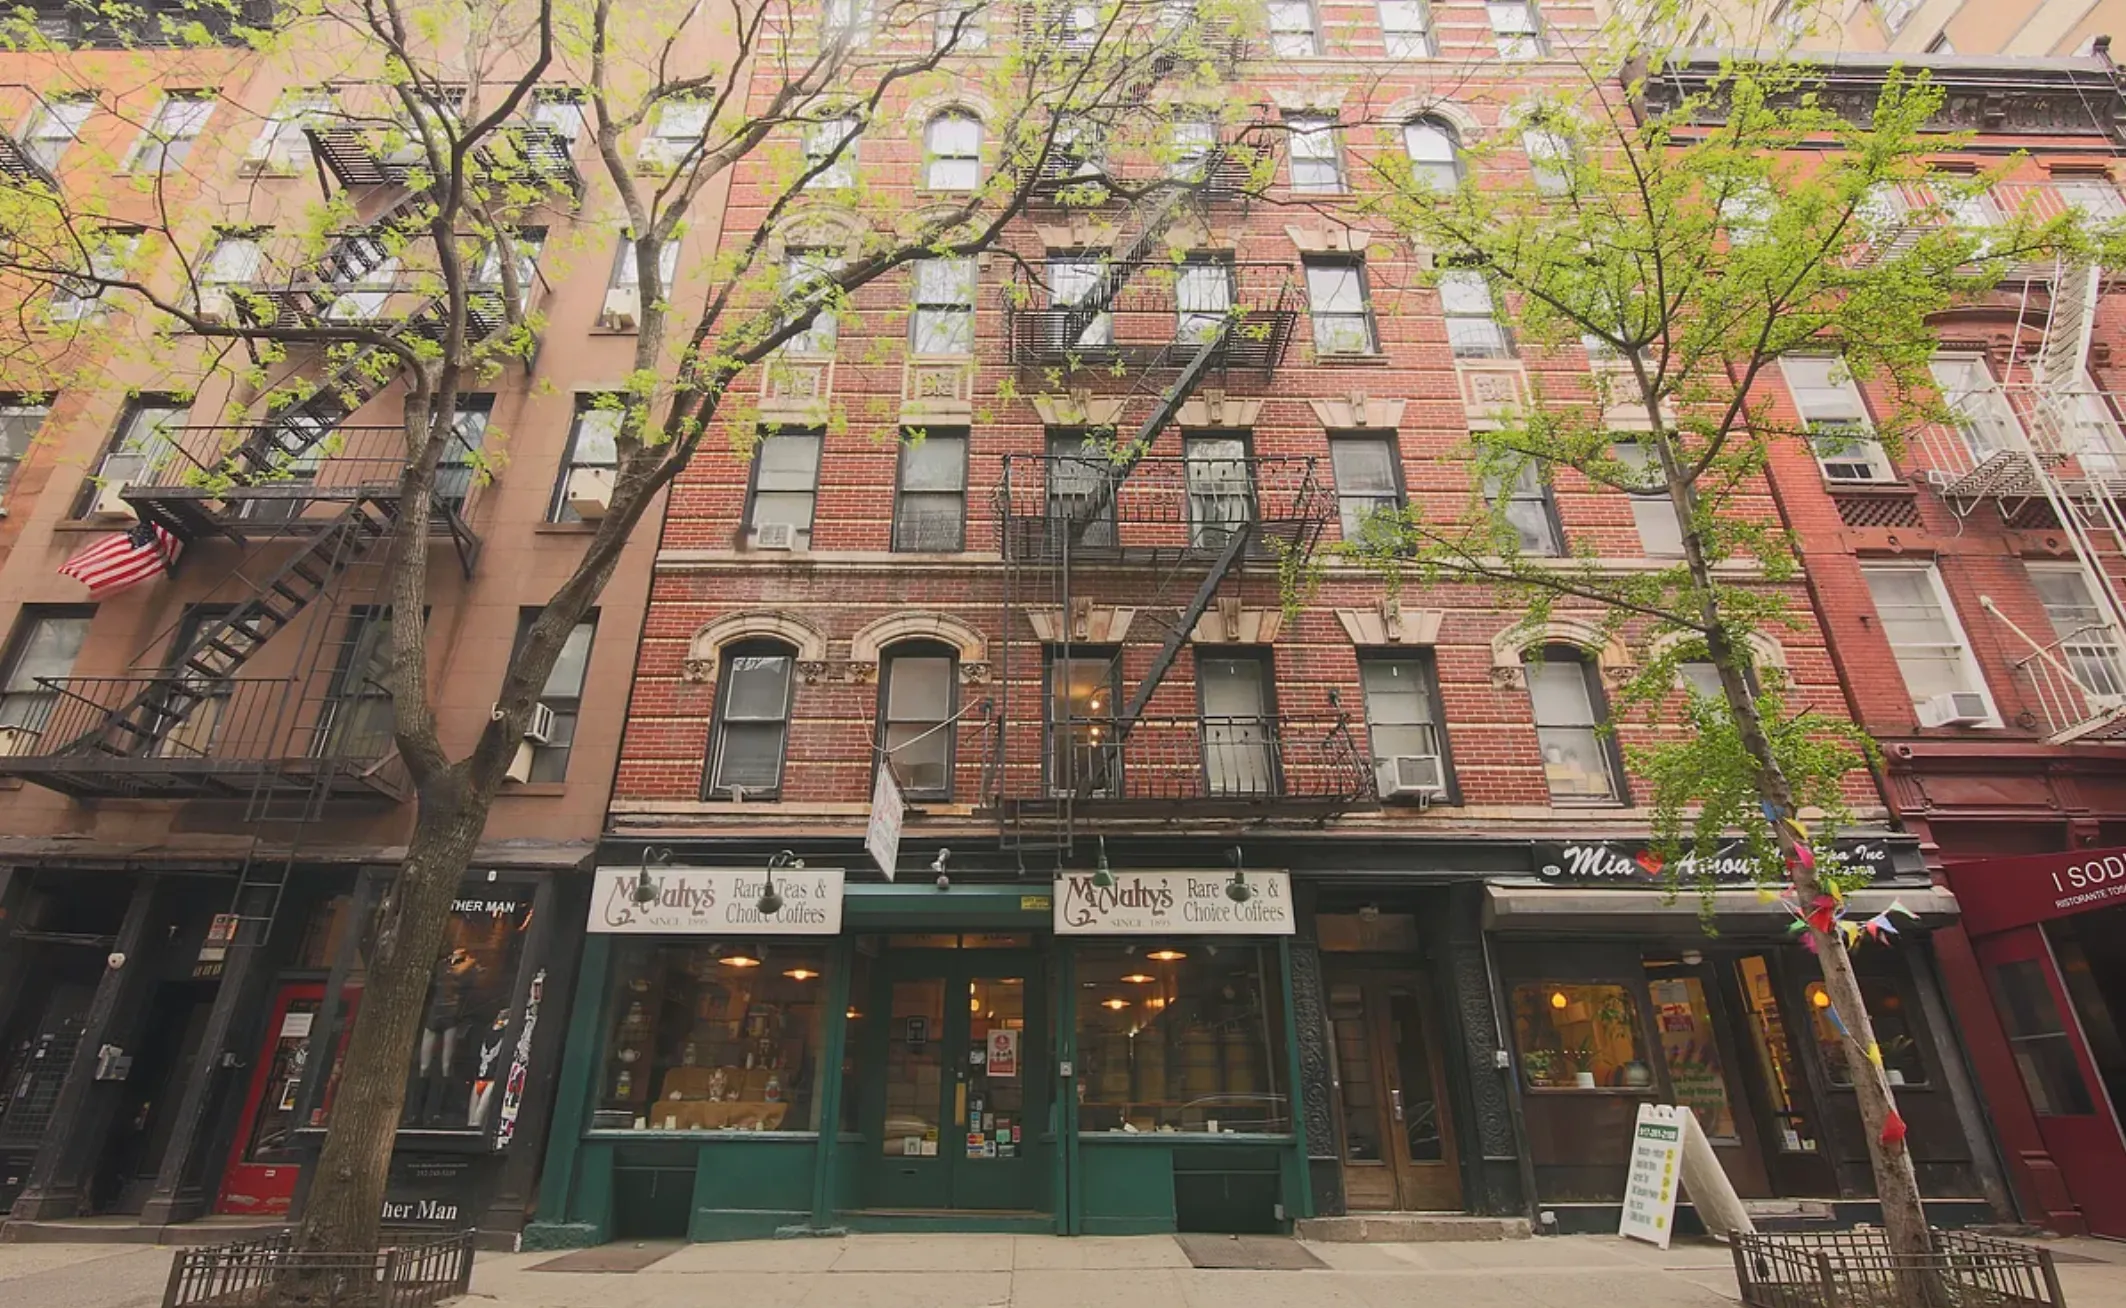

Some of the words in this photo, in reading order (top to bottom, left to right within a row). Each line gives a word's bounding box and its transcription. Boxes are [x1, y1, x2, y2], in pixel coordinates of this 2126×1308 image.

[1563, 845, 1635, 876] Mia
[1812, 845, 1850, 865] Spa
[1855, 844, 1885, 861] Inc
[2051, 872, 2064, 892] I
[2067, 853, 2126, 889] SOD
[776, 878, 808, 899] Teas
[814, 878, 827, 899] &
[1187, 878, 1220, 898] Rare
[1268, 878, 1279, 899] &
[2055, 889, 2107, 909] RISTORANTE
[485, 901, 516, 914] MAN
[776, 900, 826, 924] Coffees
[1183, 901, 1231, 922] Choice
[1233, 900, 1286, 922] Coffees
[416, 1200, 459, 1220] Man
